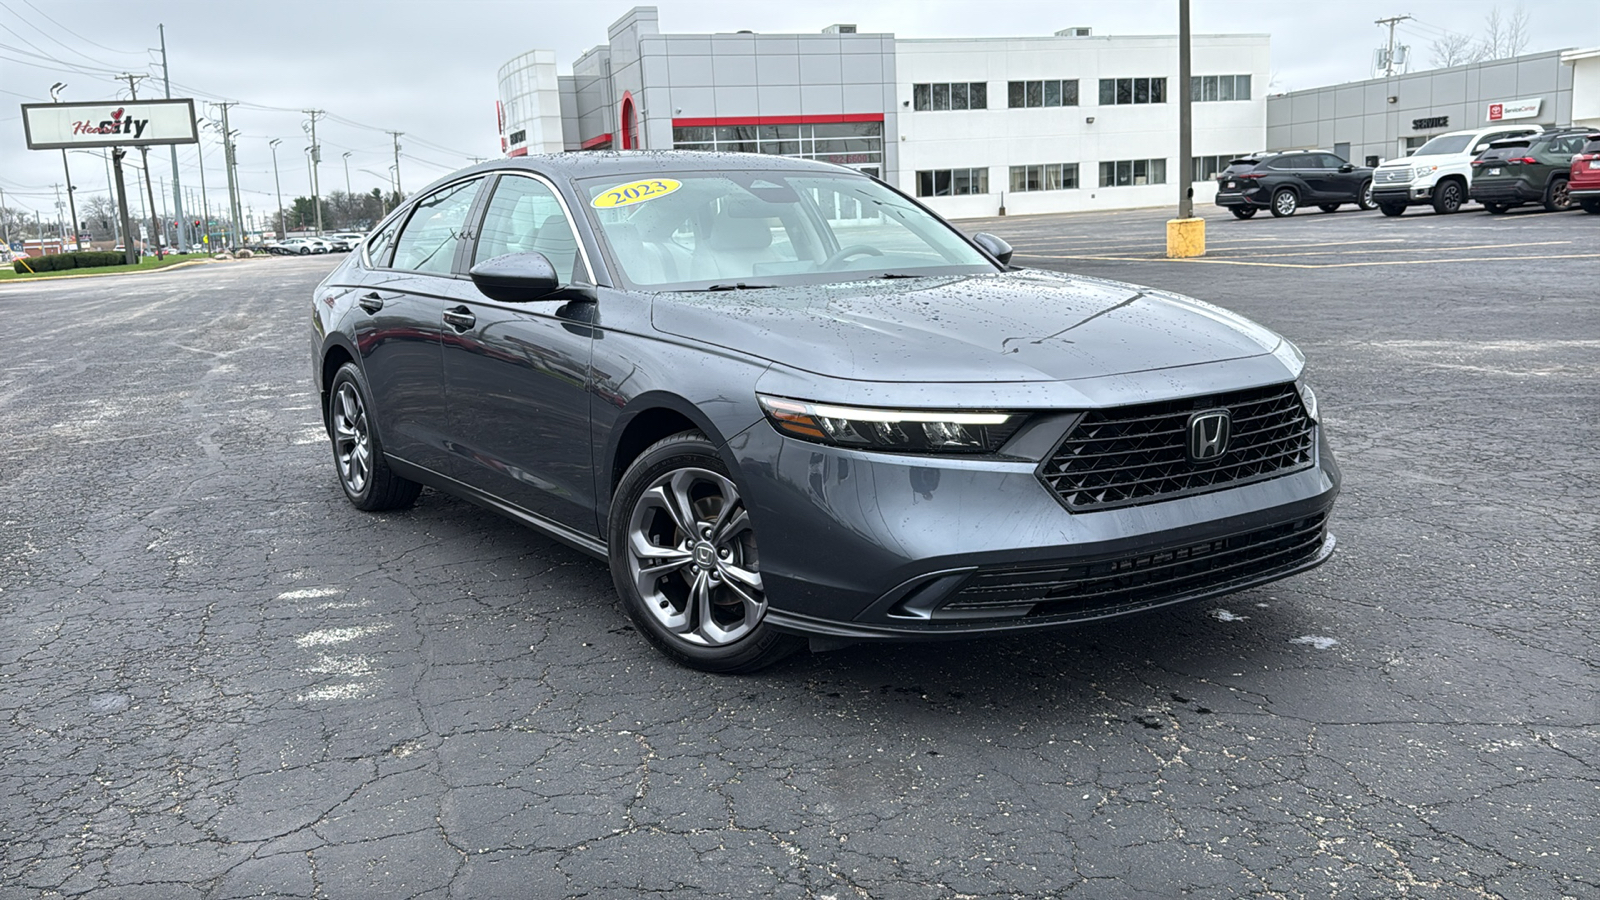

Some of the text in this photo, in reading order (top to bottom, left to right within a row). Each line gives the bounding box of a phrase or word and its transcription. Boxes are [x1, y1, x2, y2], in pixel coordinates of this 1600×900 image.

[72, 119, 124, 135] Heart
[1412, 115, 1449, 130] SERVICE
[607, 181, 668, 205] 2023
